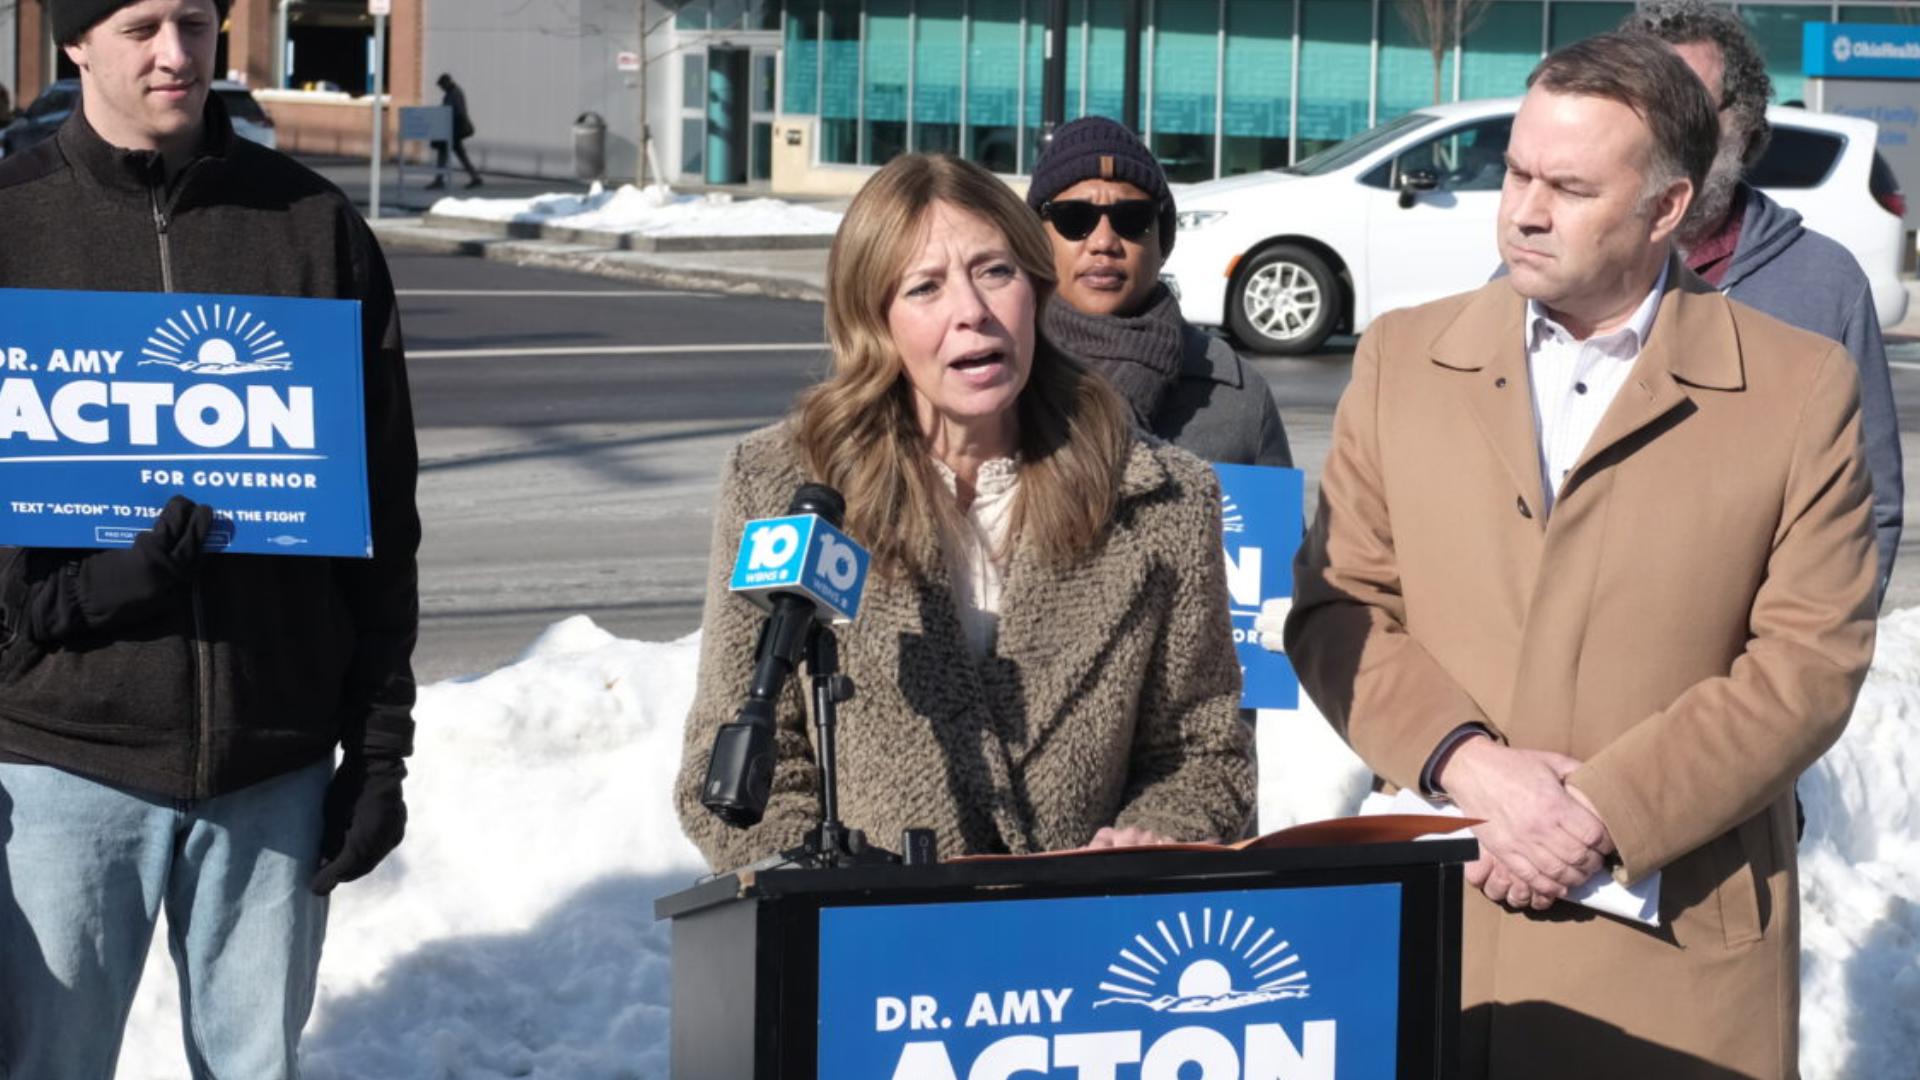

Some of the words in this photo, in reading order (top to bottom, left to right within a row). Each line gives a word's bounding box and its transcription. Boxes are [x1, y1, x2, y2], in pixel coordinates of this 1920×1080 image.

[0, 346, 38, 371] R.
[47, 348, 124, 374] AMY
[0, 377, 316, 449] ACTON
[141, 469, 184, 486] FOR
[193, 471, 317, 488] GOVERNOR
[11, 502, 44, 514] TEXT
[47, 503, 110, 515] "ACTON"
[113, 505, 131, 516] TO
[236, 510, 260, 522] THE
[265, 511, 307, 523] FIGHT
[748, 524, 799, 569] 10
[817, 533, 857, 590] 10
[875, 997, 952, 1032] DR.
[965, 988, 1074, 1027] AMY
